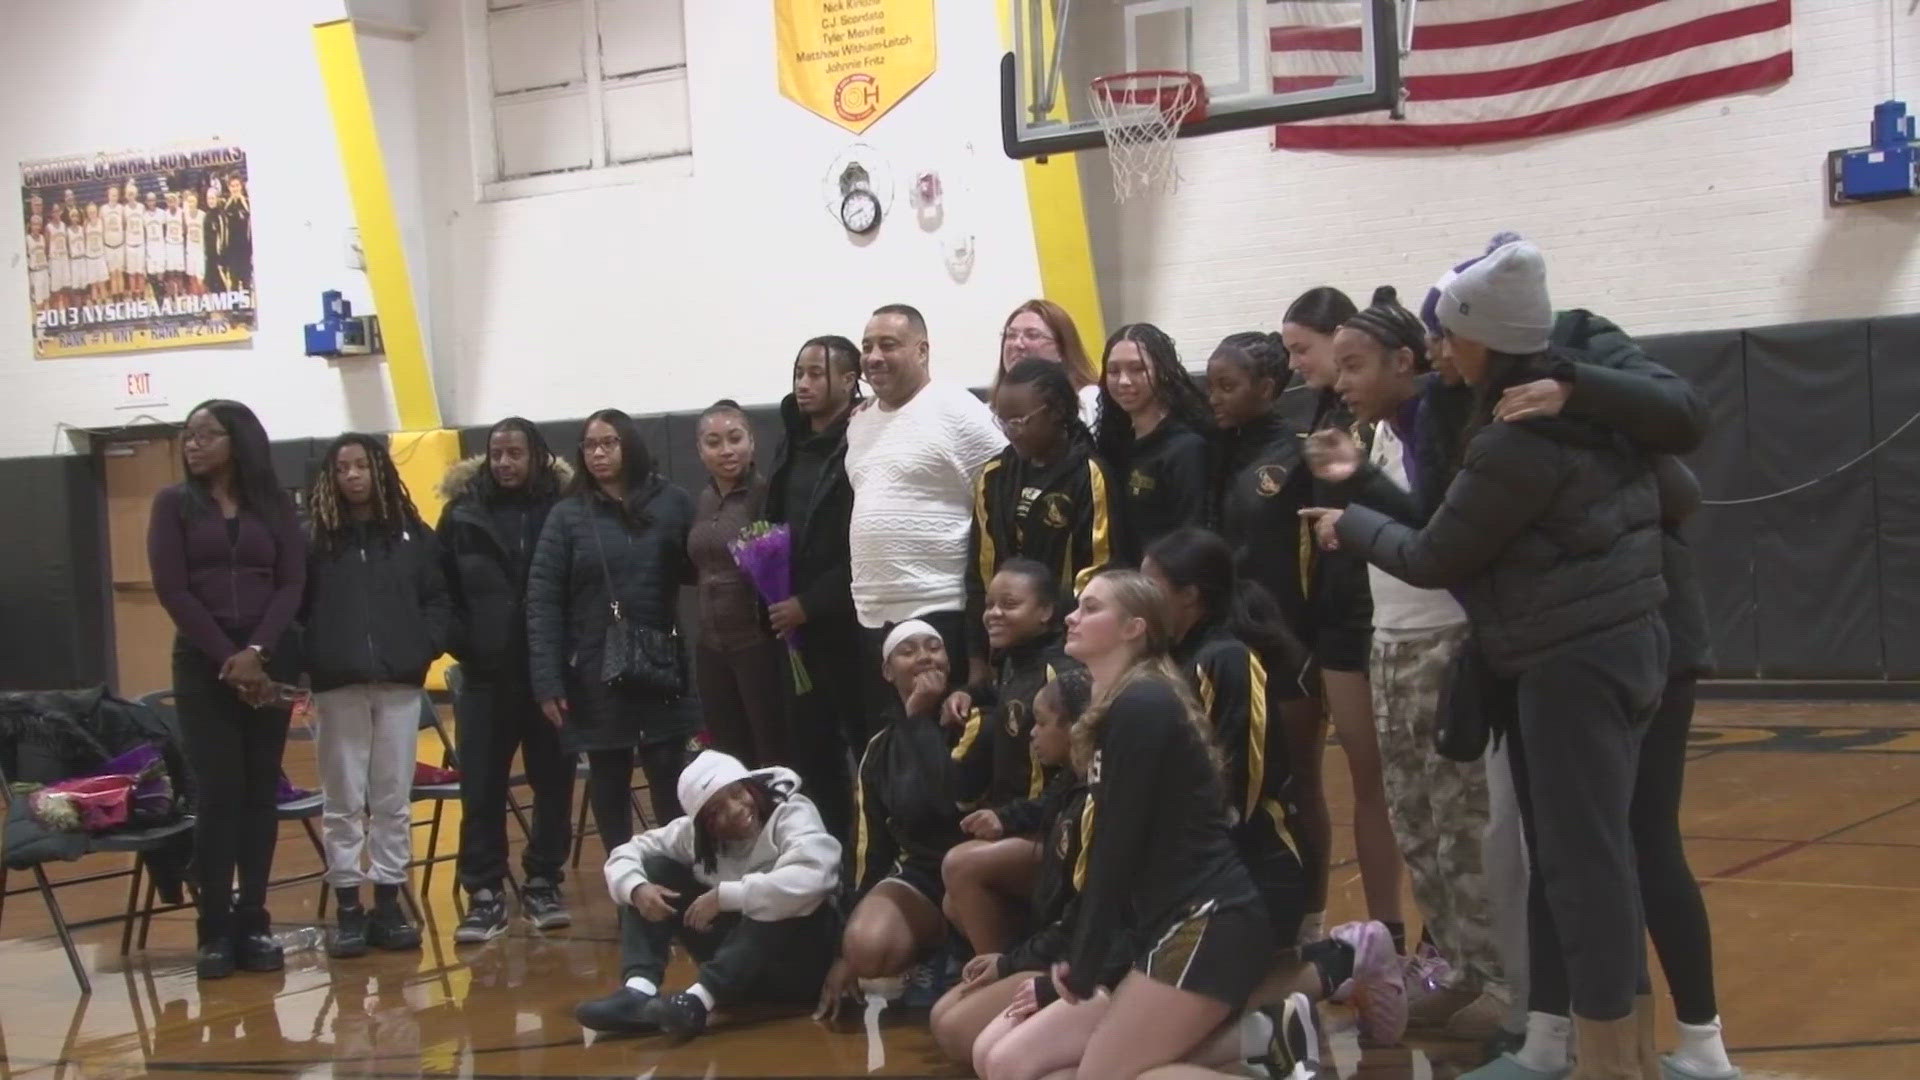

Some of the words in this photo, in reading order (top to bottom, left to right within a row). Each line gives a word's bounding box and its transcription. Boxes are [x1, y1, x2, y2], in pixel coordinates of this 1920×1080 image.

[23, 158, 90, 187] CARDINAL
[151, 151, 187, 173] LADY
[36, 307, 79, 328] 2013
[59, 331, 87, 348] RANK
[151, 323, 179, 340] RANK
[127, 373, 150, 394] EXIT
